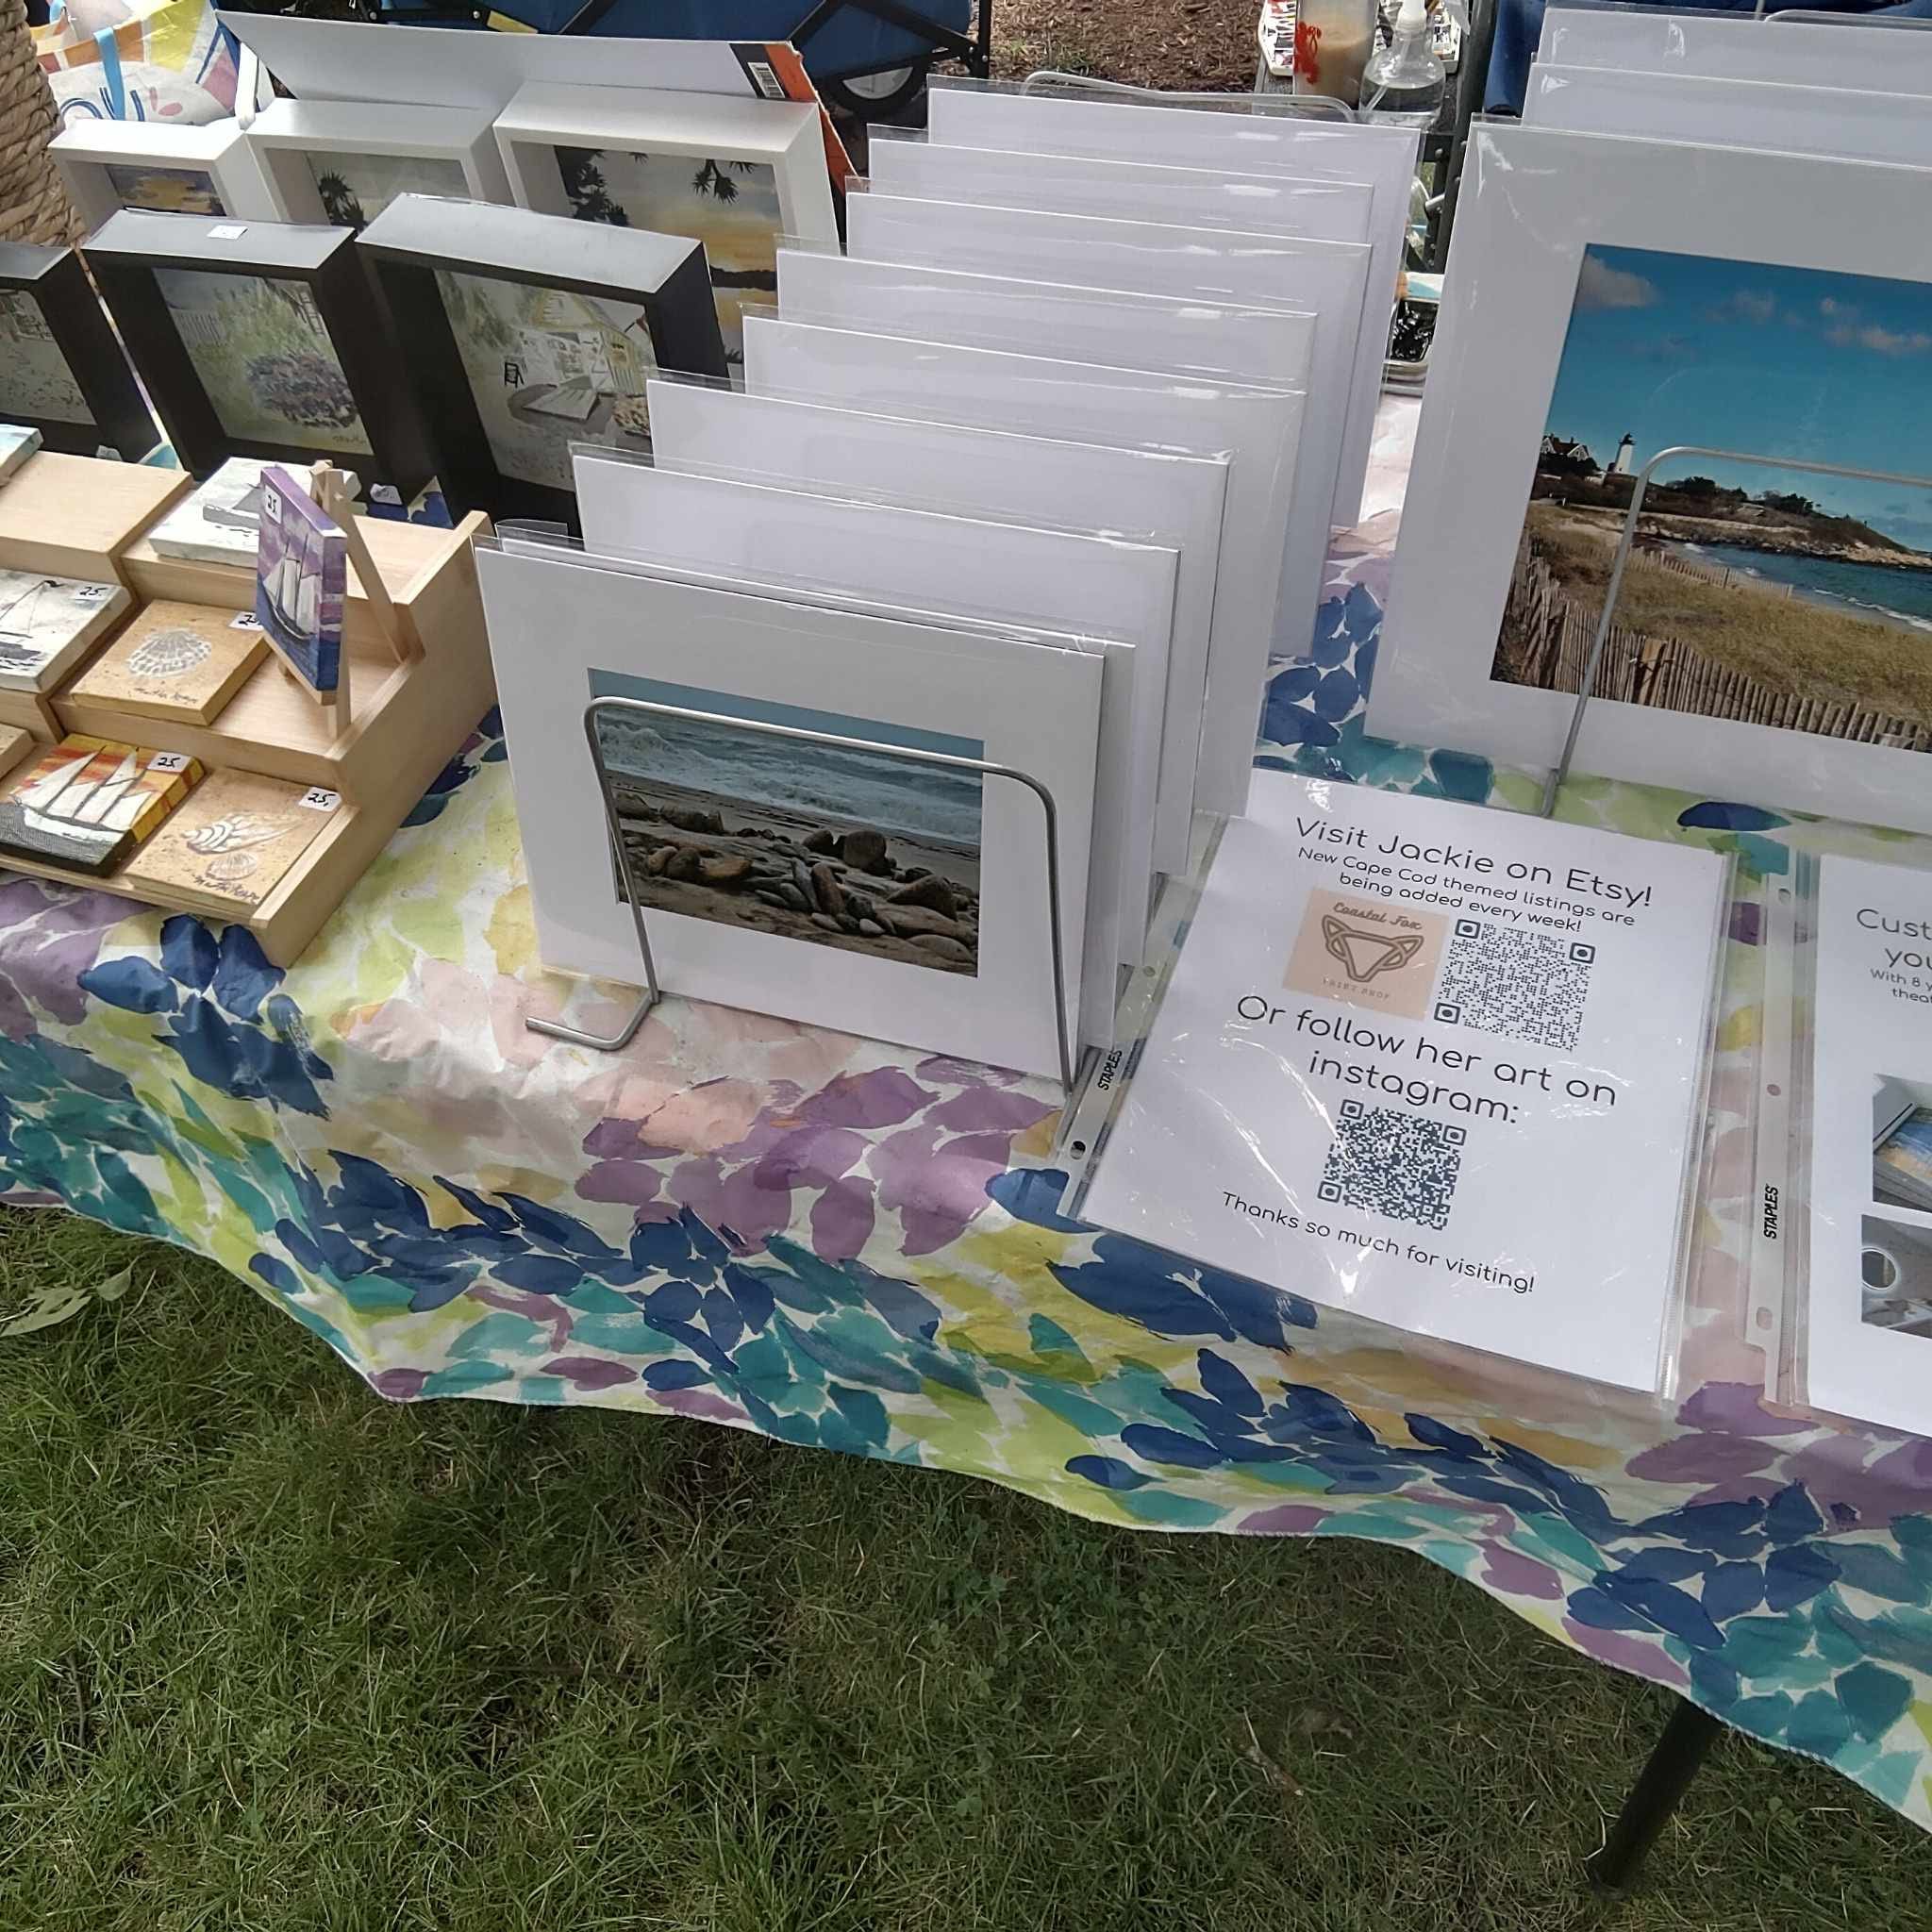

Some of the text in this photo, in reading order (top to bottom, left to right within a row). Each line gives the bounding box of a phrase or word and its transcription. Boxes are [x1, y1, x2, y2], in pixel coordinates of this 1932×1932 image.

[158, 757, 181, 768] 25
[1296, 816, 1652, 908] Visit Jackie on Etsy!
[1298, 847, 1636, 926] New Cape Cod themed listings are
[1332, 902, 1423, 930] Coastal Fox
[1340, 872, 1582, 933] being added every week!
[1870, 968, 1907, 985] With
[1910, 976, 1921, 988] 8
[1097, 1049, 1123, 1091] STAPLES
[1237, 994, 1616, 1106] Or follow her art on
[1308, 1049, 1519, 1124] instagram:
[1223, 1191, 1535, 1294] Thanks so much for visiting!
[1763, 1184, 1779, 1240] STAPLES
